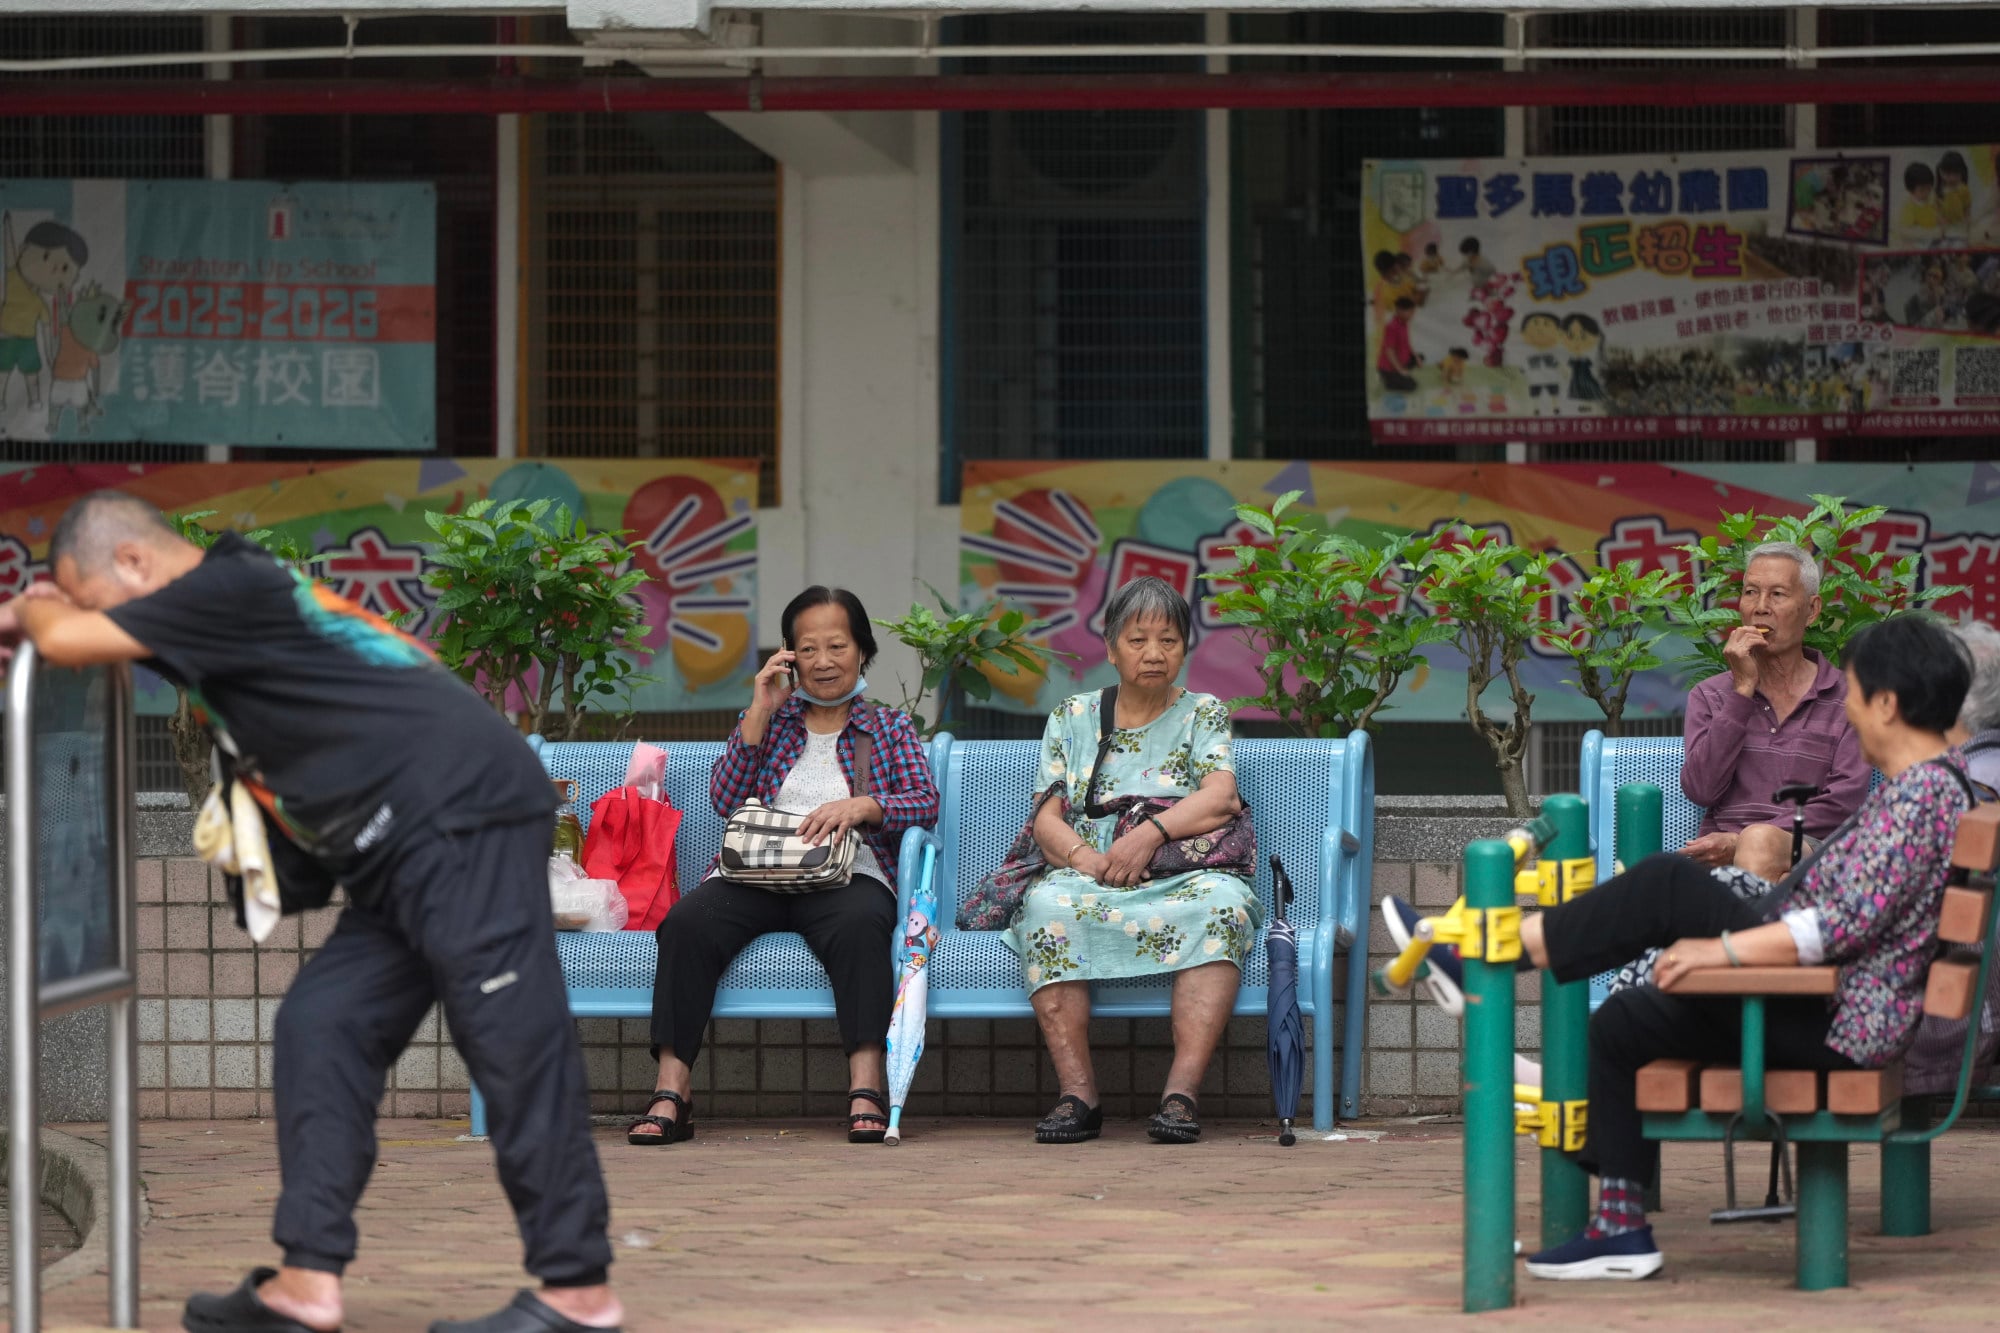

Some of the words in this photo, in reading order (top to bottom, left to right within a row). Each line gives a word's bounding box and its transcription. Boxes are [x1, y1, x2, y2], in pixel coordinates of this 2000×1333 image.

[1436, 168, 1768, 218] 聖多馬堂幼稚園
[139, 257, 248, 280] Straighten
[259, 258, 292, 280] Up
[300, 258, 377, 280] School
[1524, 222, 1745, 299] 現正招生
[133, 344, 378, 407] 護脊校園
